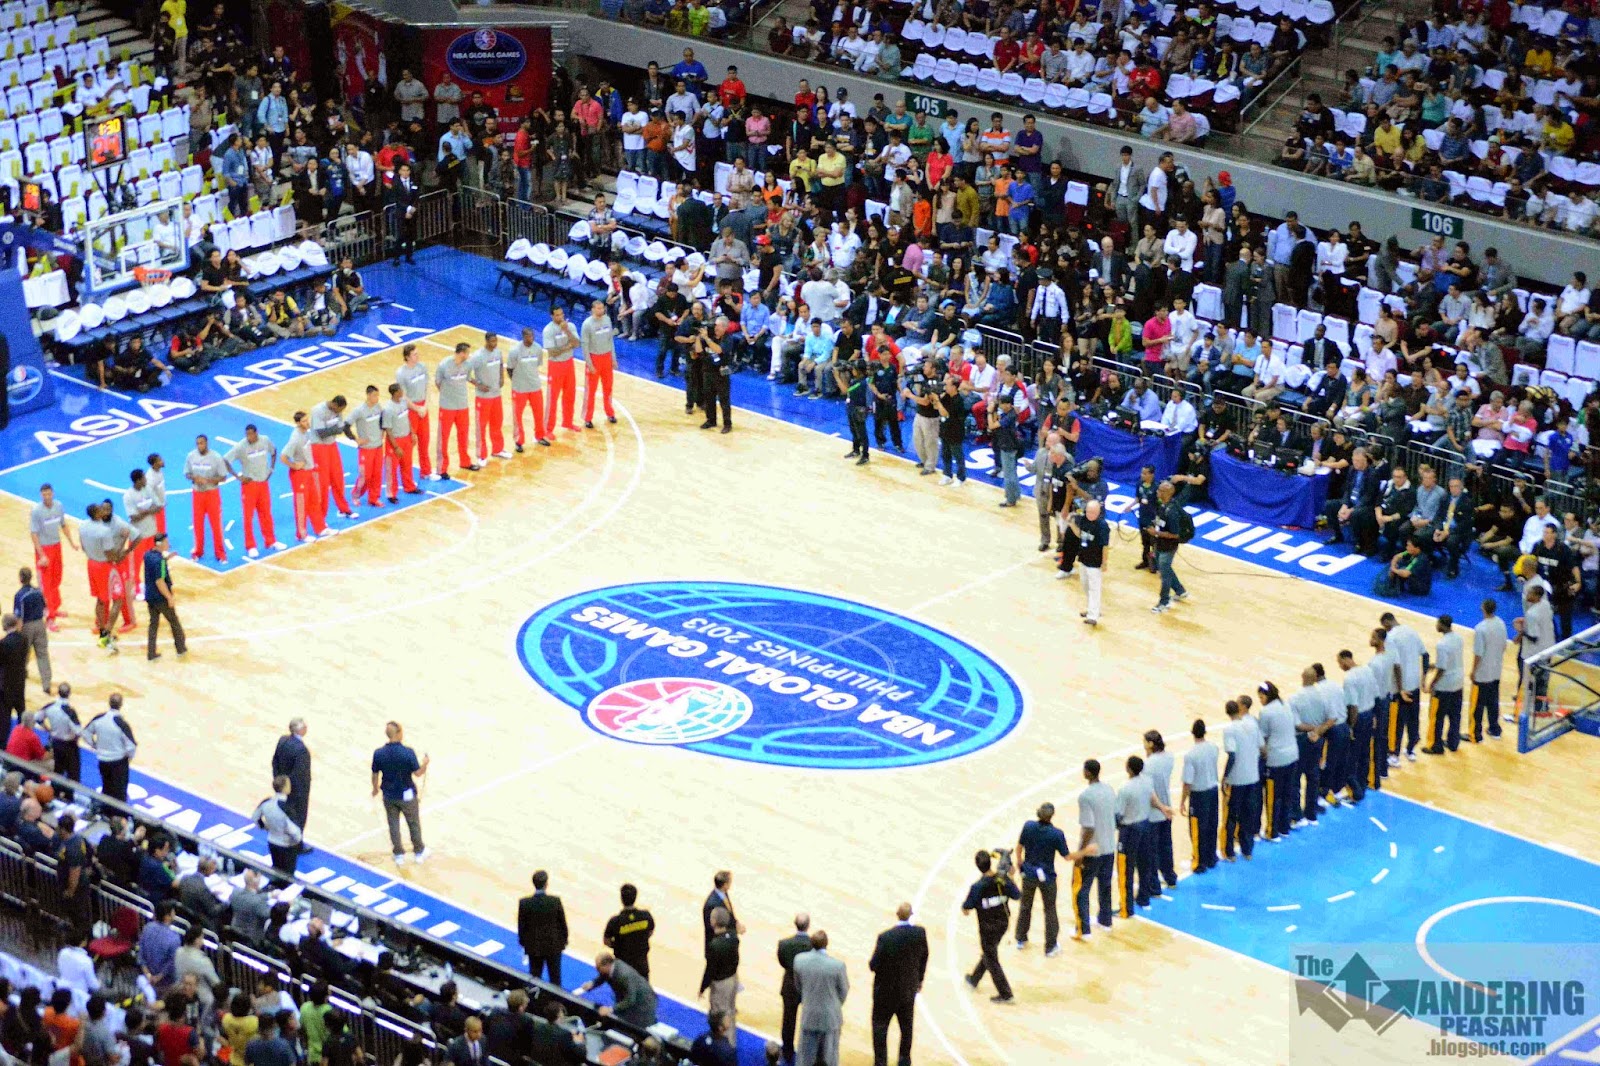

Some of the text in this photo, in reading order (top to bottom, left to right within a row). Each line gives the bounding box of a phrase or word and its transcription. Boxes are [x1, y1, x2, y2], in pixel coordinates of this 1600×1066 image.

[913, 95, 940, 116] 105
[1422, 212, 1453, 235] 106
[34, 322, 435, 453] ASIA ARENA
[571, 605, 957, 746] NBA GLOBAL GAMES
[682, 617, 912, 701] PHILIPPINES 2013
